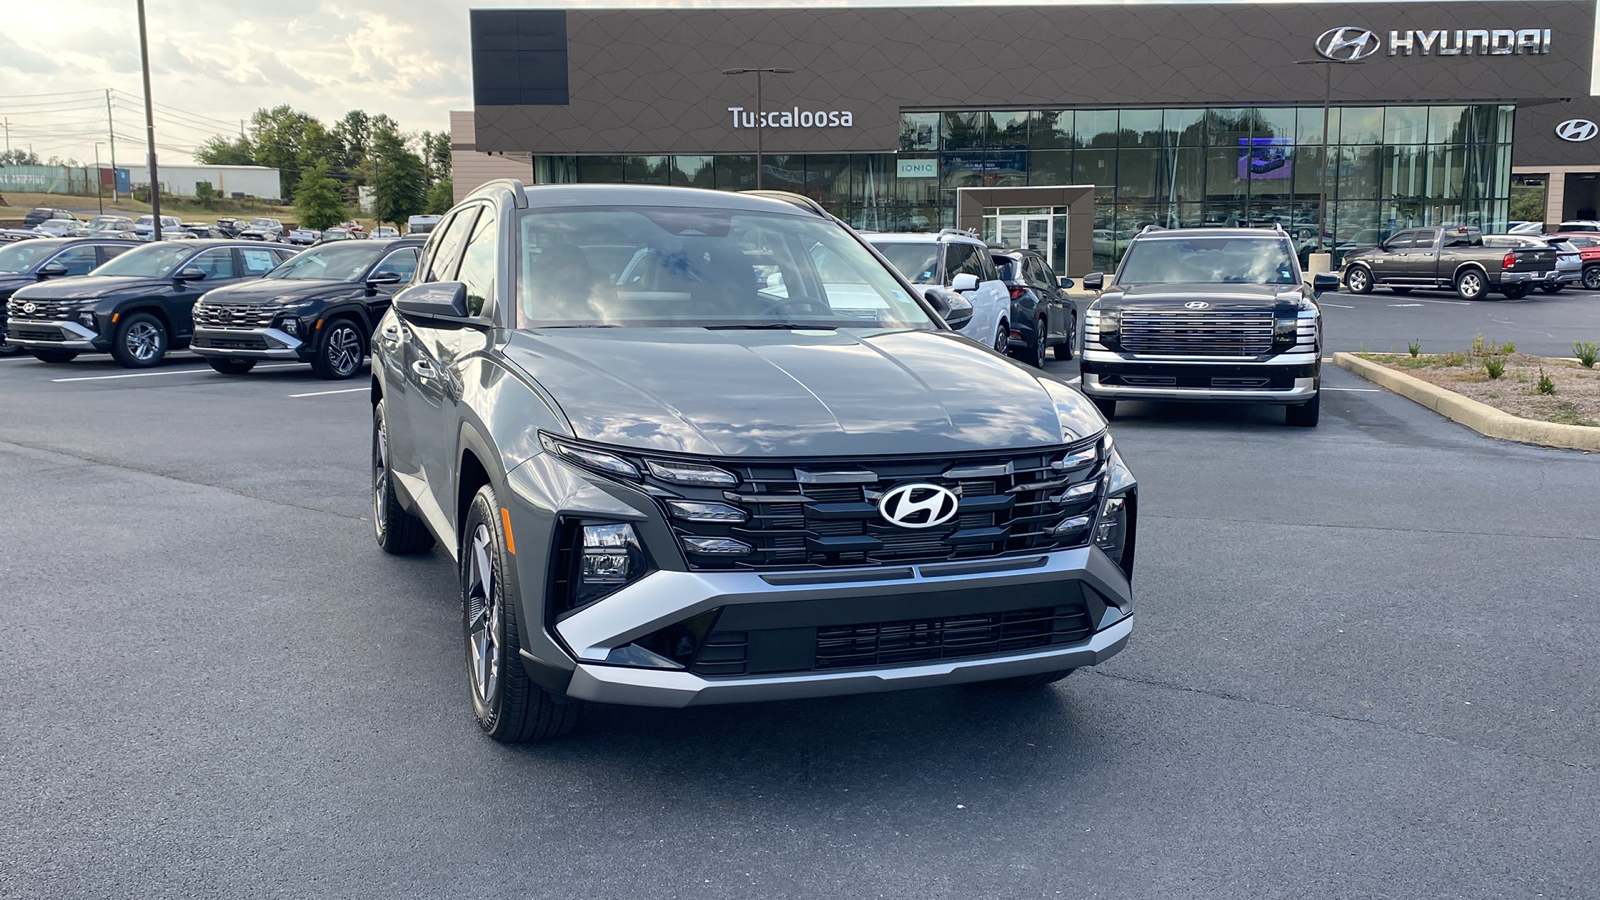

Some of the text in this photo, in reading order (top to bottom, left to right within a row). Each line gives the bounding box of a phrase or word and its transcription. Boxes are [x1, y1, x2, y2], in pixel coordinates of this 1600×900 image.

[1387, 28, 1552, 56] HYUNDAI
[727, 106, 853, 128] Tuscaloosa
[901, 164, 933, 172] IONIQ
